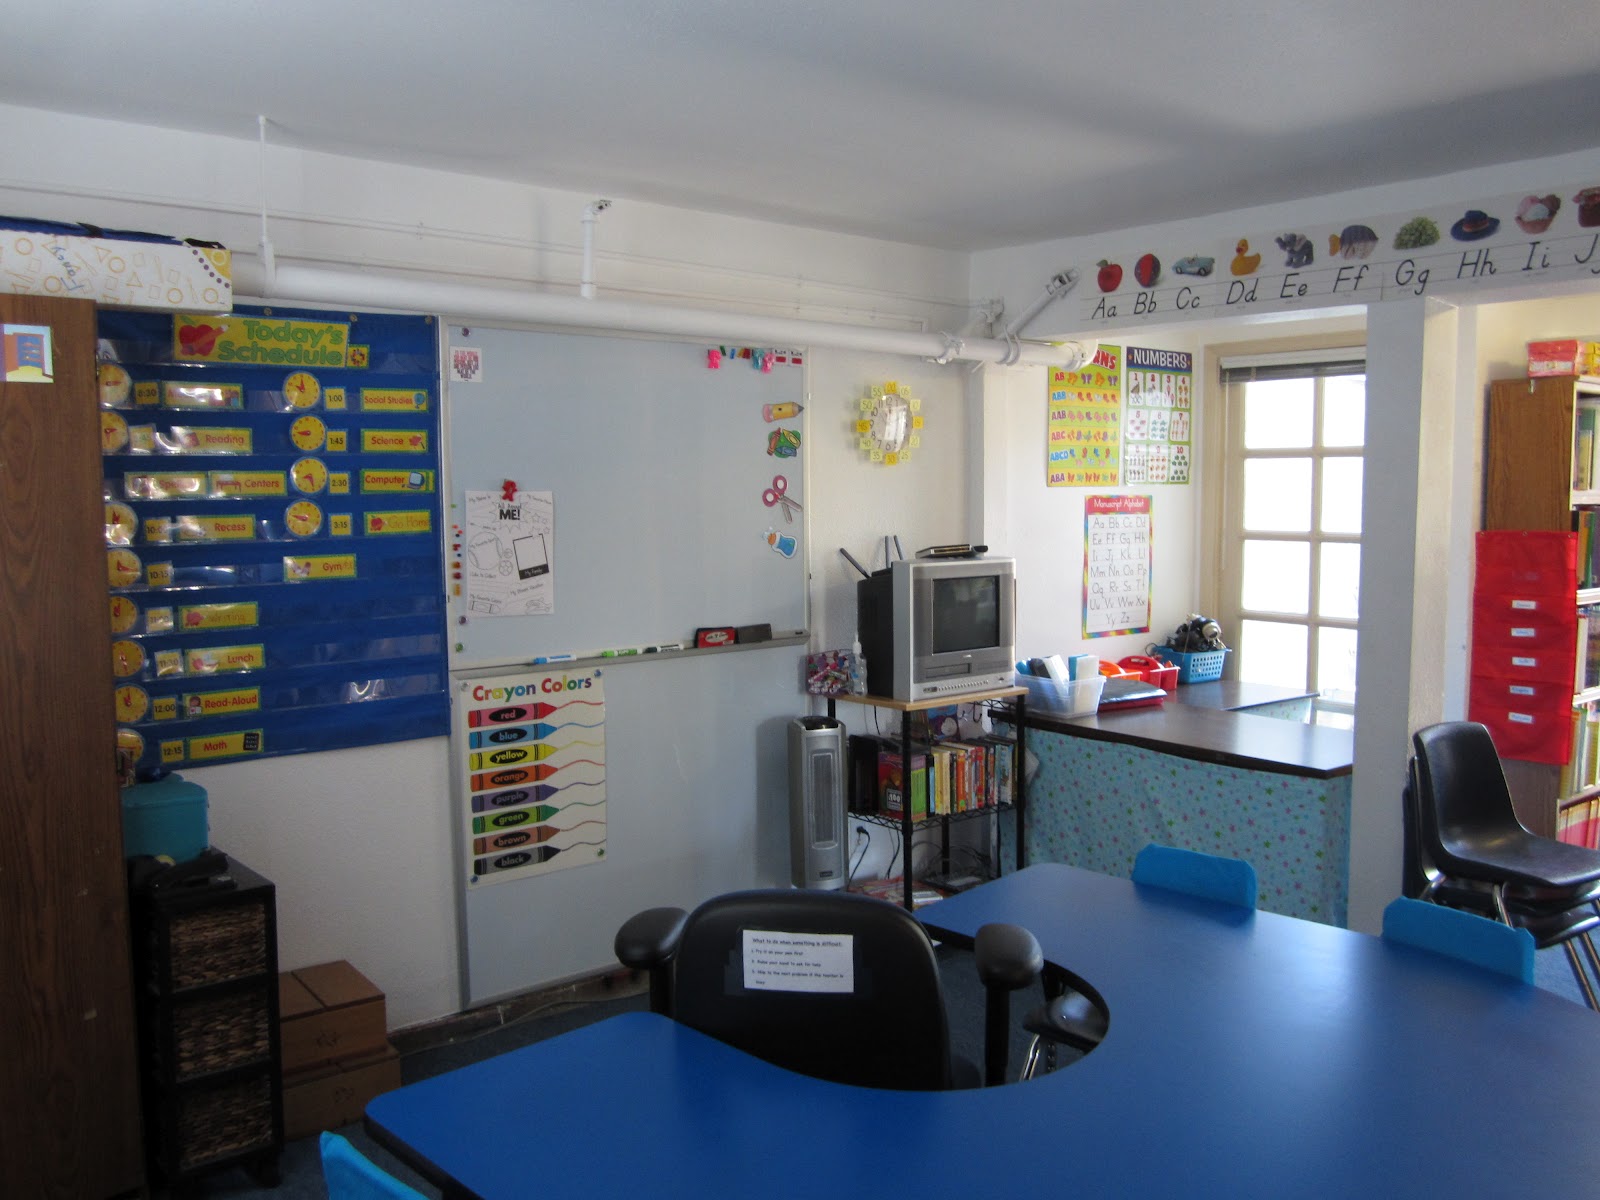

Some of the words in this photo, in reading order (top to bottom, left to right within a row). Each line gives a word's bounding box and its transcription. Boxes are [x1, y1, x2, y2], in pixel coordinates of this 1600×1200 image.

[1091, 296, 1117, 320] Aa
[1133, 291, 1157, 315] Bb
[1176, 287, 1200, 310] Cc
[1226, 278, 1259, 305] Dd
[1280, 272, 1308, 299] Ee
[1332, 263, 1369, 293] Ff
[1395, 259, 1430, 295] Gg
[1456, 248, 1497, 279] Hh
[1521, 241, 1550, 271] Ii
[243, 320, 344, 348] Today's
[218, 340, 343, 365] Schedule
[1133, 348, 1187, 369] NUMBERS
[1054, 372, 1065, 381] AB
[364, 396, 385, 404] Social
[388, 396, 413, 404] Studies
[1051, 410, 1067, 420] AAB
[205, 433, 244, 446] Reading
[329, 437, 343, 445] 1:45
[371, 436, 404, 445] Science
[1051, 431, 1066, 441] ABC
[1176, 446, 1183, 454] 10
[244, 479, 280, 488] Centers
[331, 479, 347, 487] 2:30
[365, 474, 405, 485] Computer
[1050, 473, 1065, 484] ABA
[1093, 499, 1122, 511] Manuscript
[1123, 499, 1145, 510] Alphabet
[499, 509, 520, 520] ME!
[214, 522, 246, 532] Recess
[333, 521, 348, 529] 3:15
[322, 562, 343, 573] Gym
[227, 653, 254, 664] Lunch
[472, 683, 536, 702] Crayon
[541, 675, 592, 695] Colors
[154, 702, 176, 713] 12:00
[204, 694, 257, 709] Read-Aloud
[500, 709, 516, 720] red
[499, 729, 518, 741] blue
[163, 746, 182, 756] 12:15
[203, 740, 228, 751] Math
[495, 750, 525, 762] yellow
[494, 773, 525, 785] orange
[496, 791, 525, 804] purple
[498, 813, 524, 826] green
[498, 833, 527, 847] brown
[501, 855, 525, 868] black
